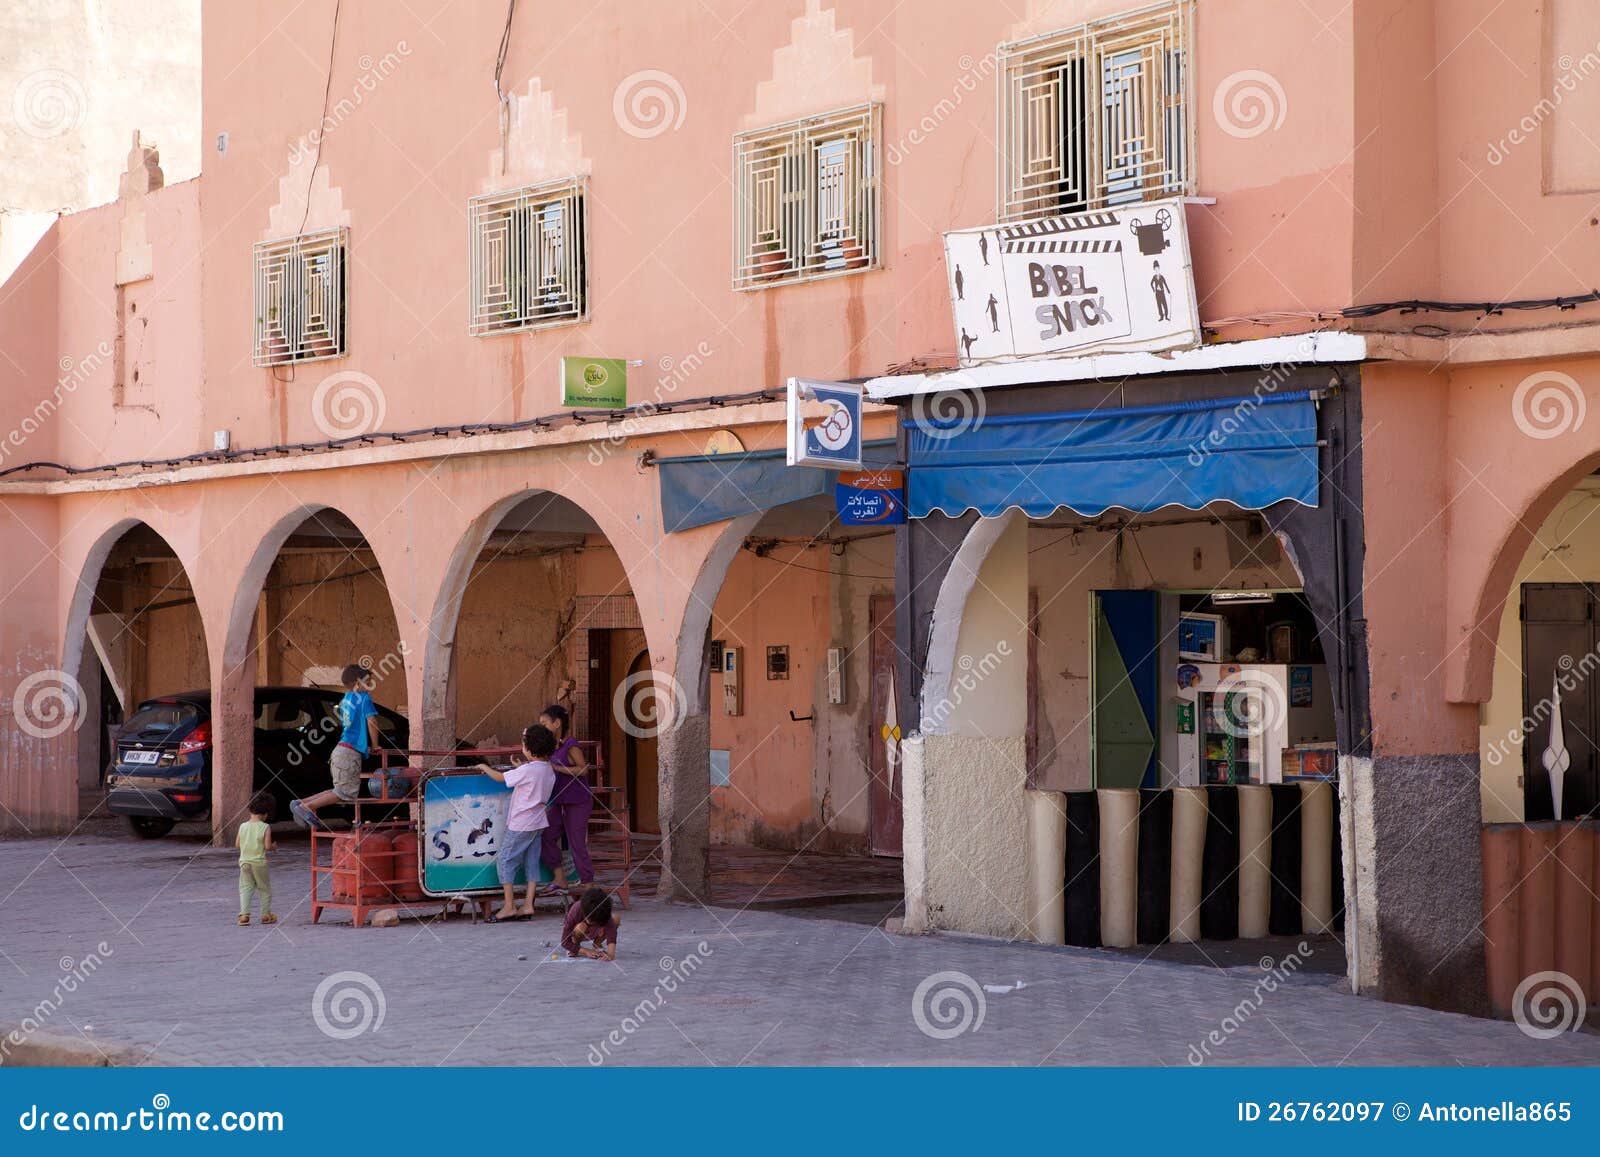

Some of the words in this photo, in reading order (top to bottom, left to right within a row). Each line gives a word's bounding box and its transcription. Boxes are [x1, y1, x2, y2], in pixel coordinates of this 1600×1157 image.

[1028, 262, 1098, 298] BABEL
[1035, 296, 1113, 340] SNACK
[847, 495, 882, 506] اتصالات
[852, 505, 877, 519] المغرب
